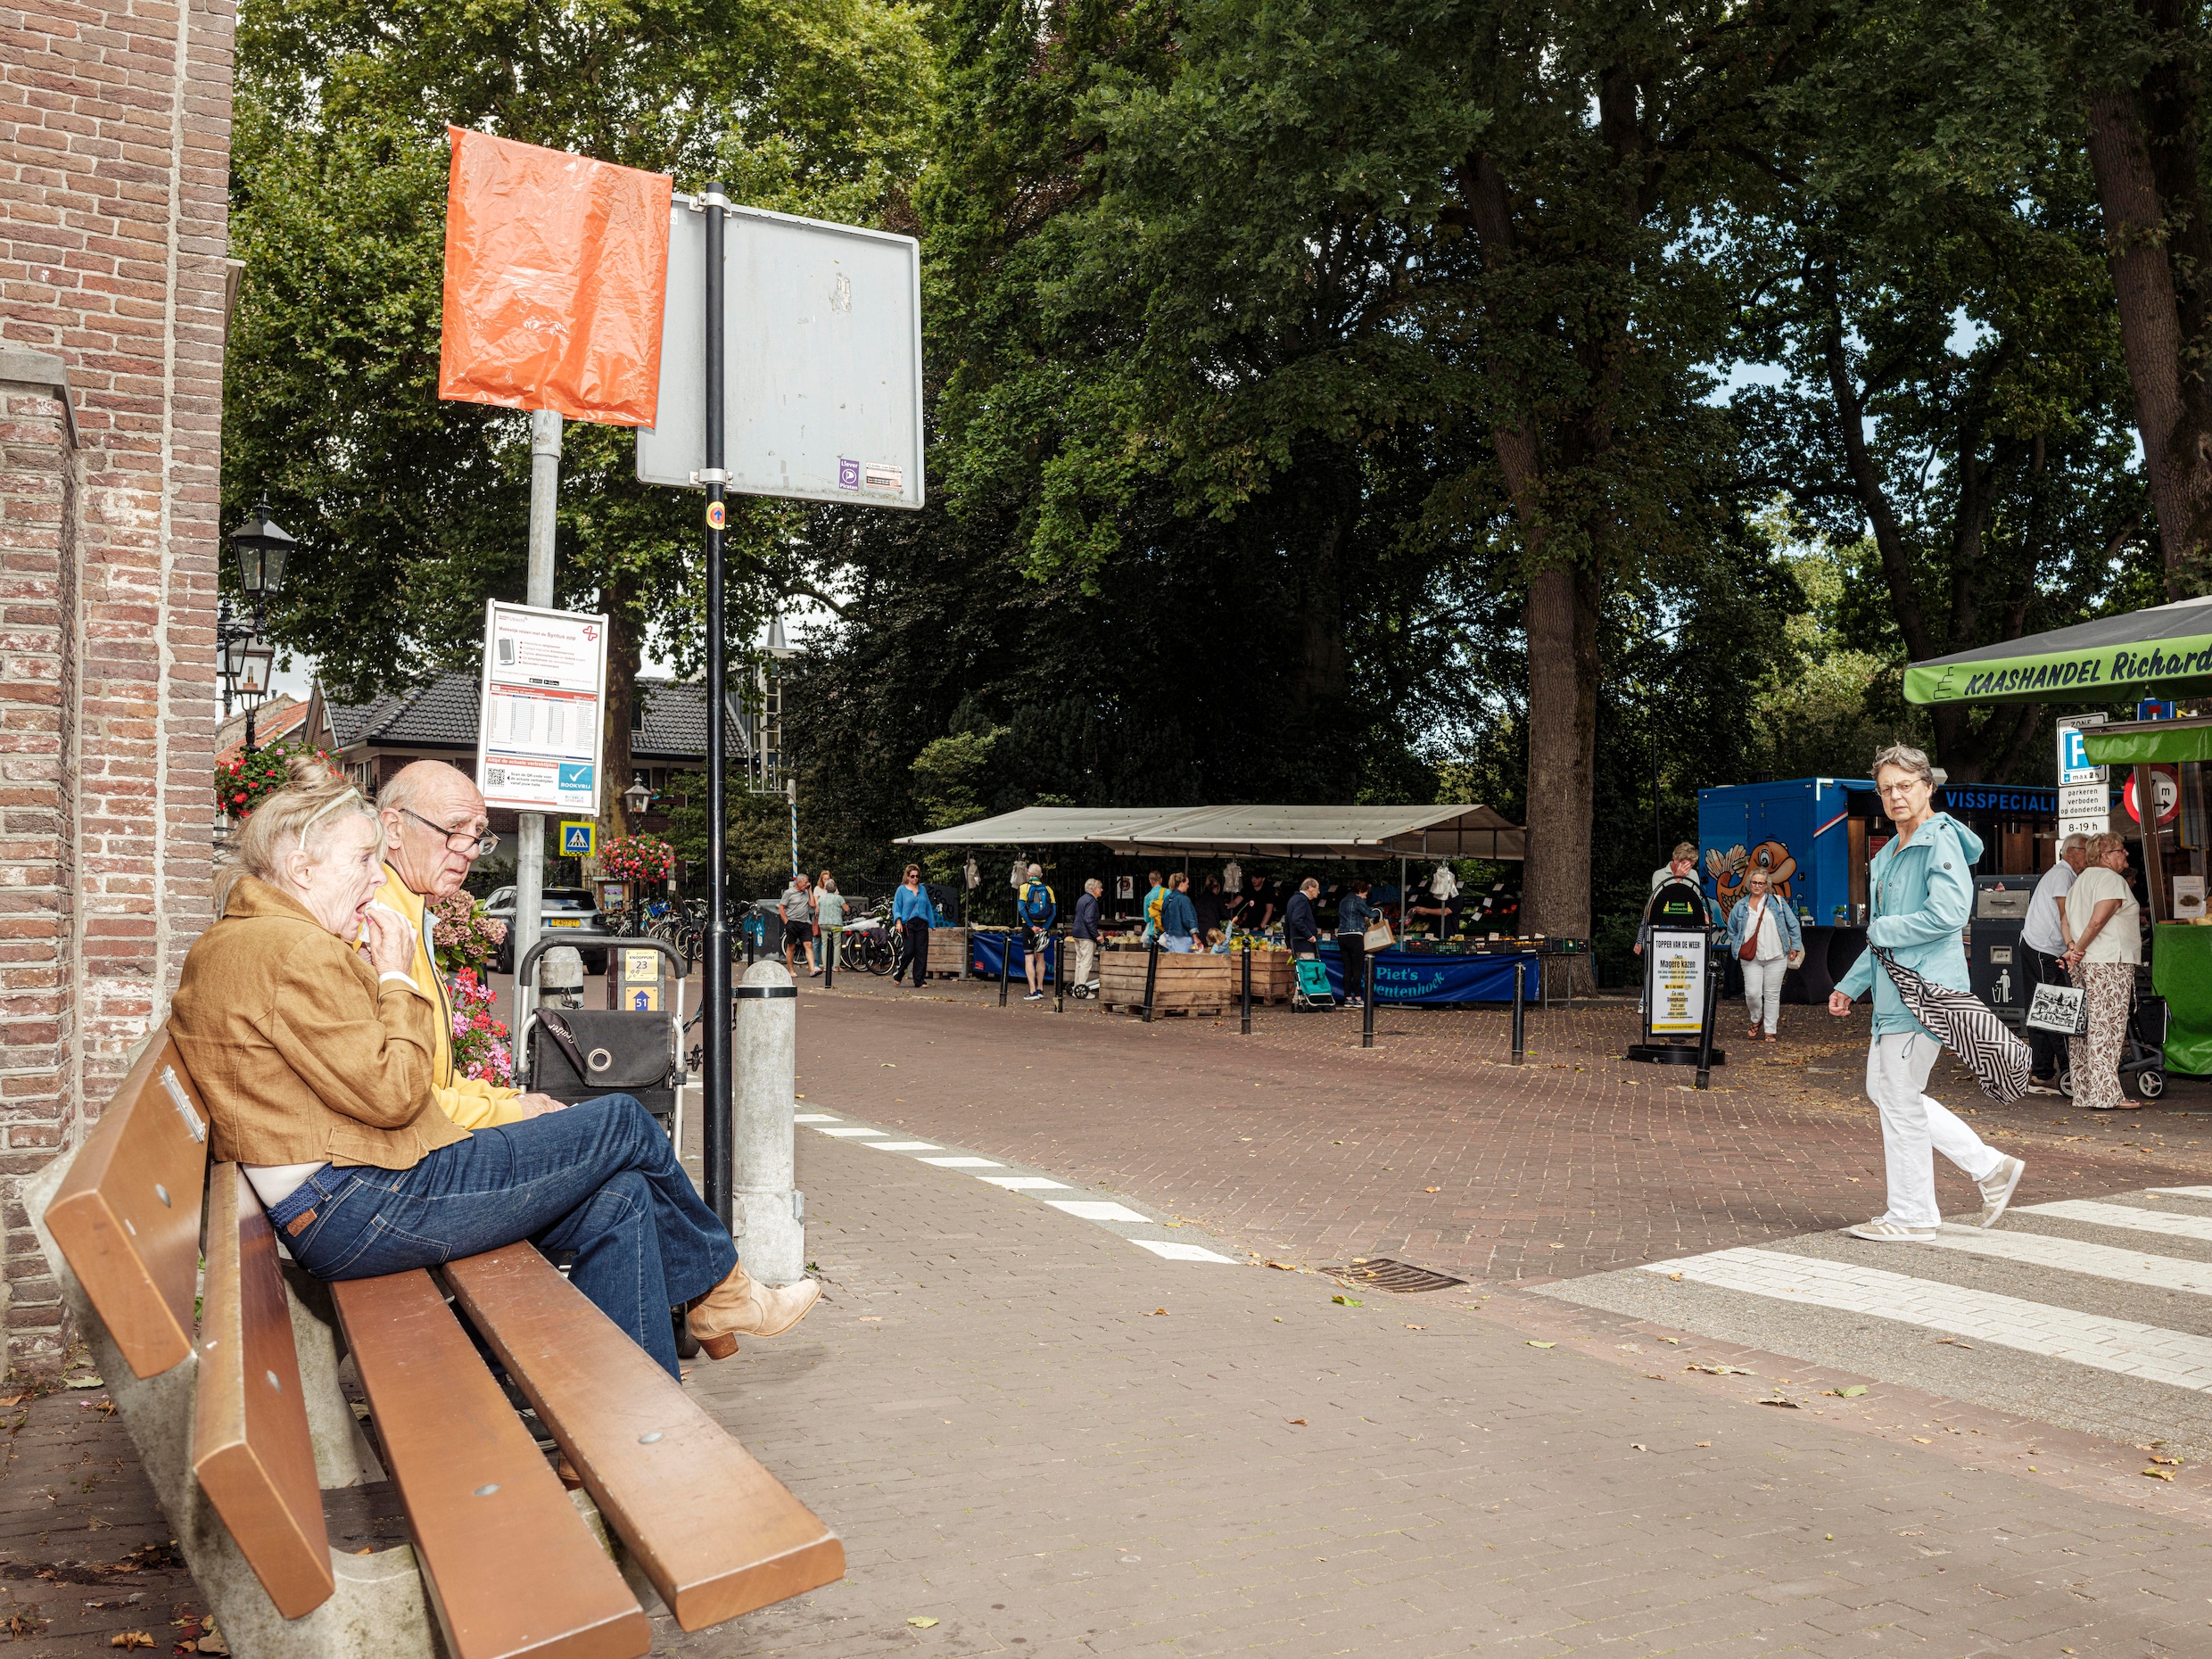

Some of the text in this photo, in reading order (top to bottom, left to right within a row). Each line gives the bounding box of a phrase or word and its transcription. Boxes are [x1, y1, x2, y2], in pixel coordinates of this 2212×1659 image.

[841, 460, 859, 468] Liever
[839, 483, 858, 491] Piraten
[1964, 644, 2212, 696] KAASHANDEL Richard
[2068, 788, 2098, 797] parkeren
[1946, 791, 2055, 812] VISSPECIALI
[2068, 797, 2099, 805] verboden
[2068, 822, 2098, 832] 8-19 h
[1655, 940, 1672, 948] TOPPER
[1681, 941, 1688, 949] DE
[636, 961, 648, 970] 23
[1660, 959, 1696, 969] Magere kazen
[1376, 967, 1418, 980] Piet's
[1361, 971, 1445, 998] entenhoek
[636, 998, 647, 1008] 51
